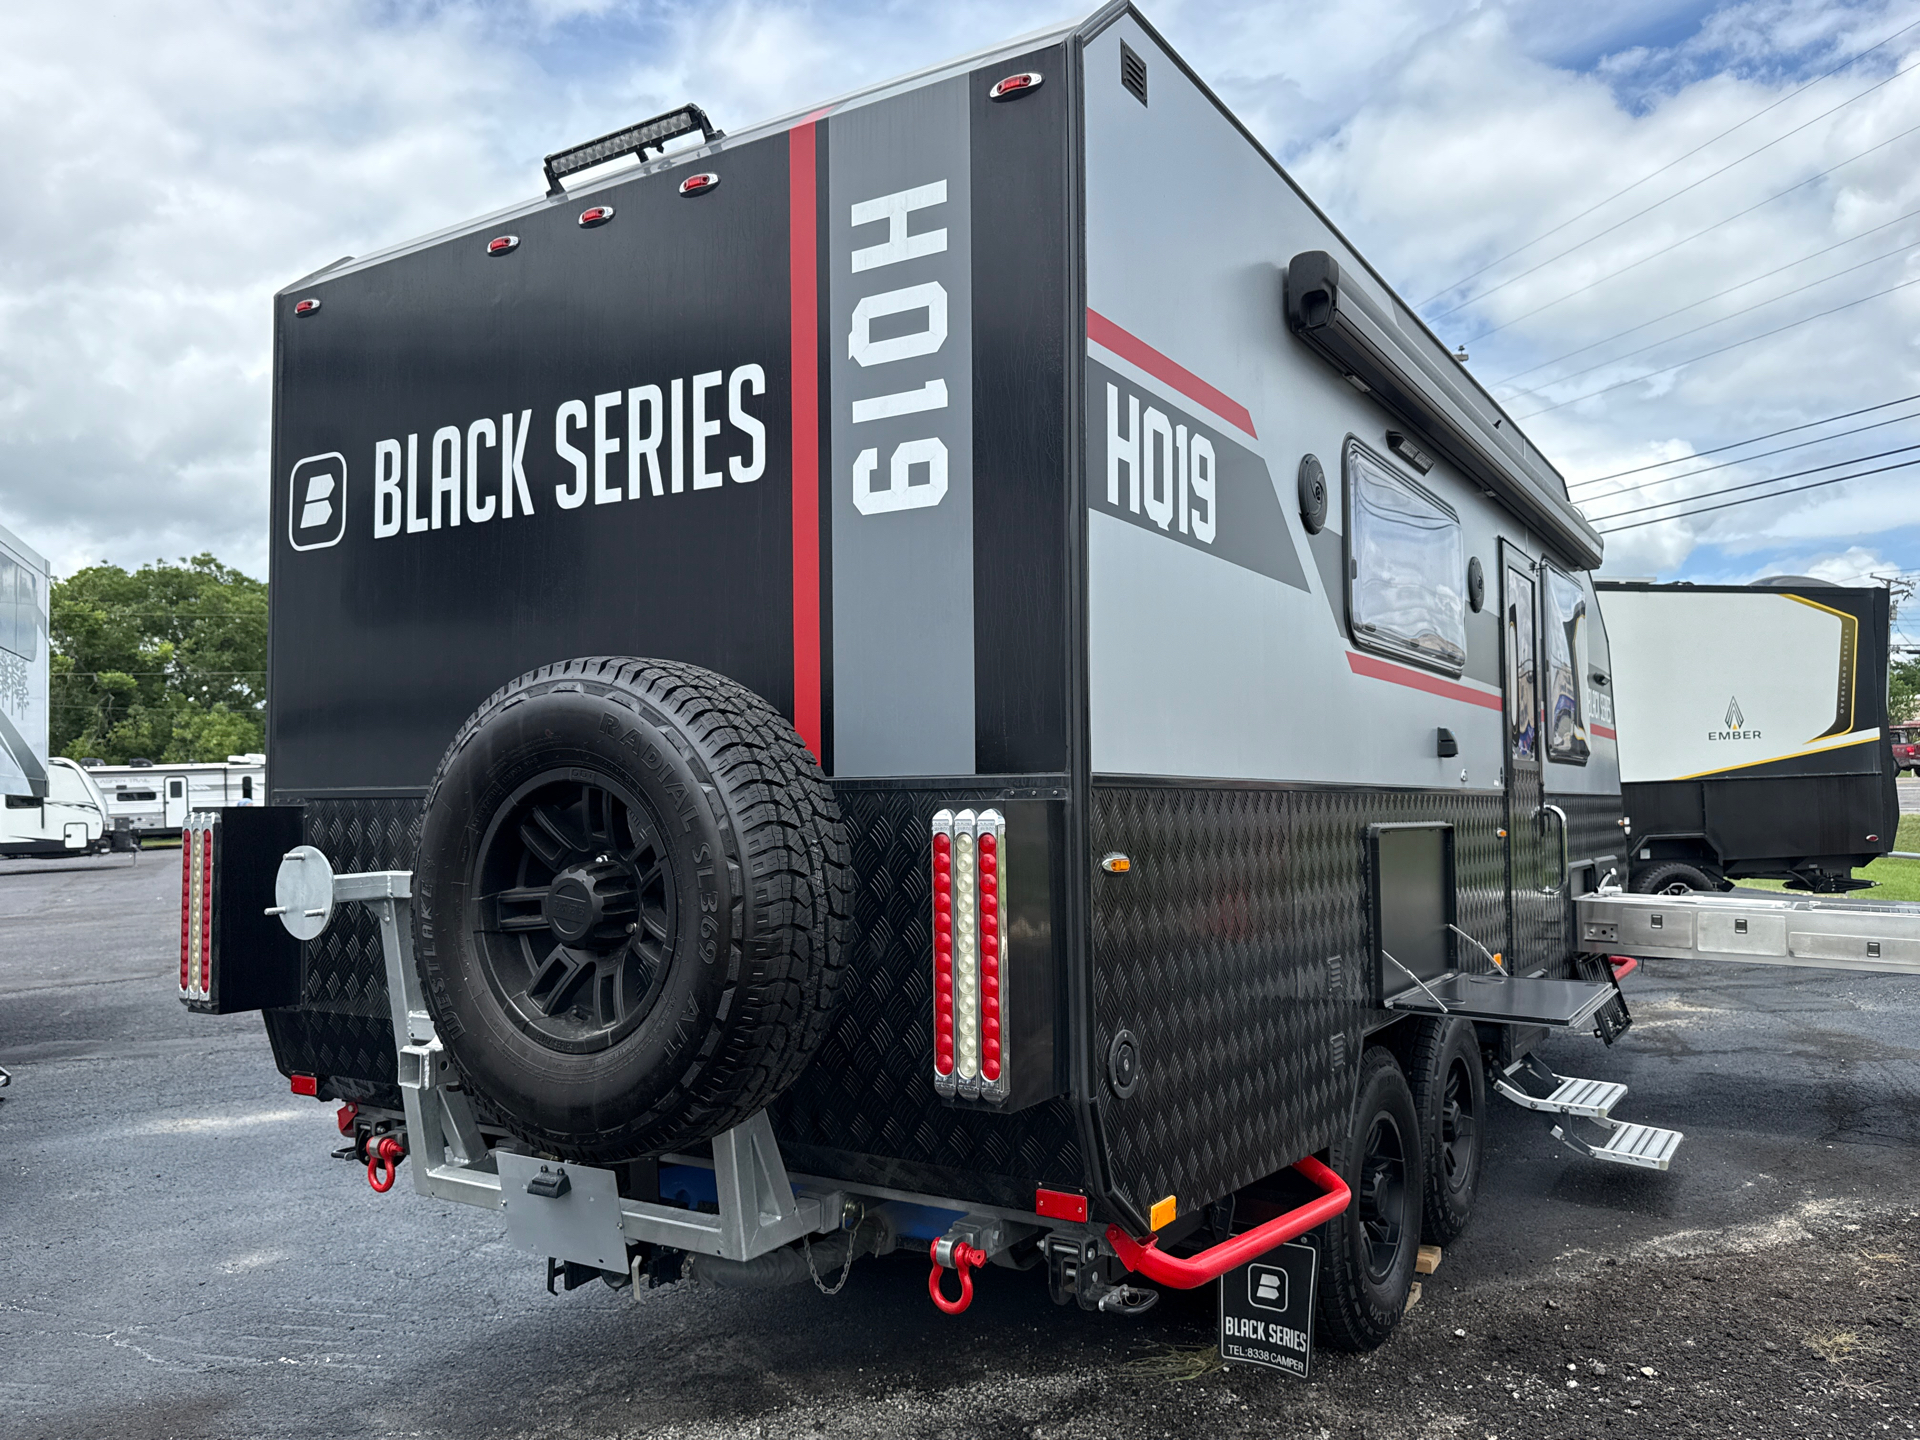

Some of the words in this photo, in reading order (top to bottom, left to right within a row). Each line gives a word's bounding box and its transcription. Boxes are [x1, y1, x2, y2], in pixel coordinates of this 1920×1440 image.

[848, 179, 948, 516] HQ19
[374, 409, 535, 539] BLACK
[555, 363, 766, 510] SERIES
[1106, 382, 1216, 544] HQ19
[599, 712, 700, 833] RADIAL
[1708, 730, 1762, 741] EMBER
[420, 880, 466, 1040] WESTLAKE
[691, 842, 719, 965] SL369
[1226, 1317, 1265, 1341] BLACK
[1269, 1324, 1306, 1352] SERIES
[1228, 1345, 1269, 1361] TEL:8338
[1271, 1353, 1304, 1372] CAMPER
